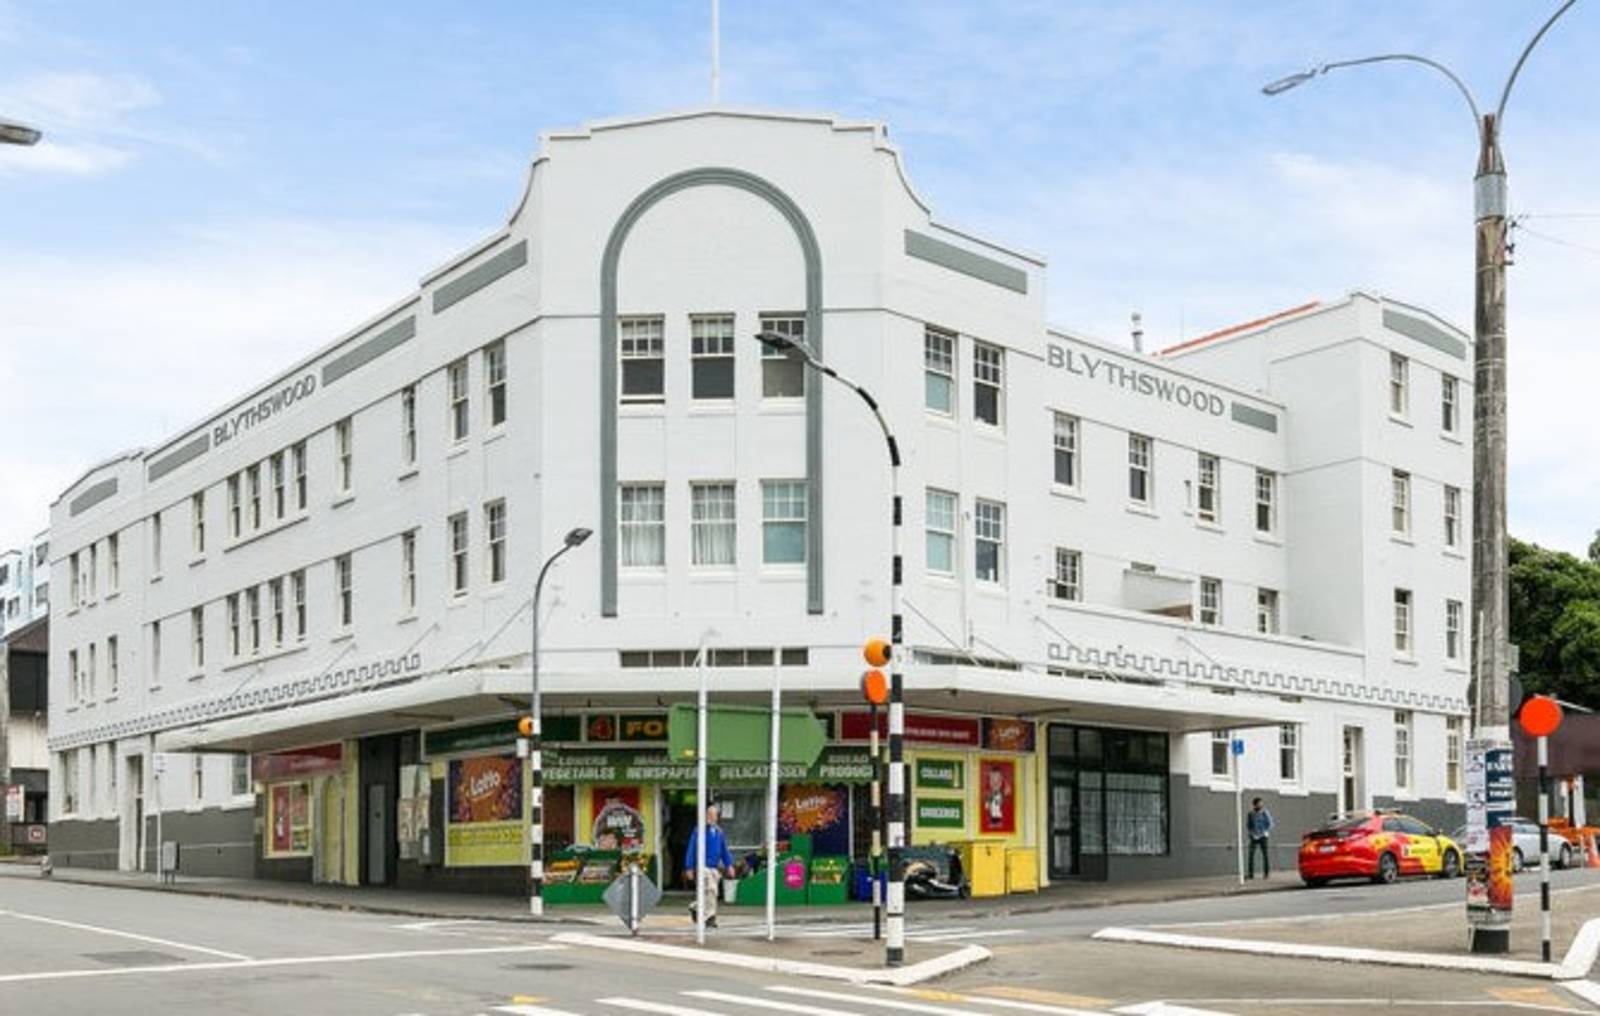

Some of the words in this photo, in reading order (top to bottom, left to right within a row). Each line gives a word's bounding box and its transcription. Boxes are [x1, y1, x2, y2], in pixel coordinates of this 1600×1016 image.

[213, 374, 317, 448] BLYTHSWOOD
[1047, 343, 1225, 416] BLYTHSWOOD
[542, 766, 616, 780] VEGETABLES
[719, 765, 807, 779] DELICATSSEN
